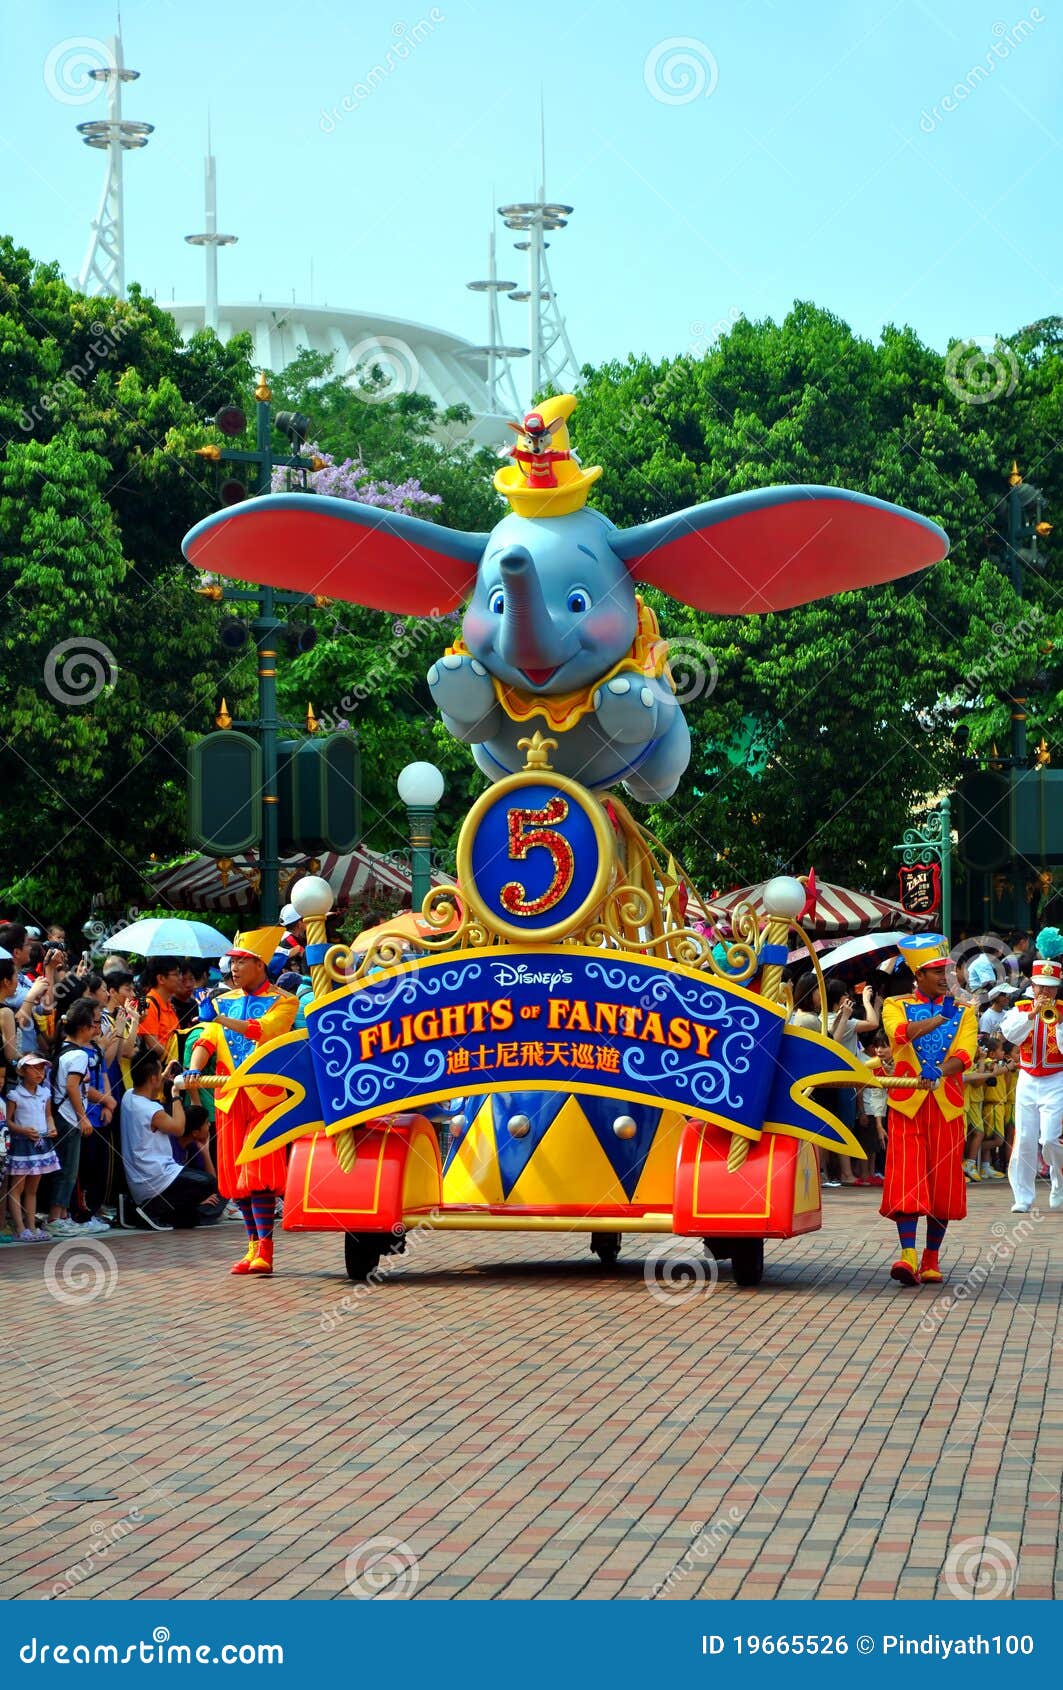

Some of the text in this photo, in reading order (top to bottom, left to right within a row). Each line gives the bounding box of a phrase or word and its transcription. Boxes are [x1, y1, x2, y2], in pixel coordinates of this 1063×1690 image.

[500, 797, 574, 916] 5
[906, 873, 927, 891] TAXI
[358, 998, 719, 1061] FLIGHTS OF FANTASY
[446, 1040, 621, 1075] 迪士尼飛天巡遊
